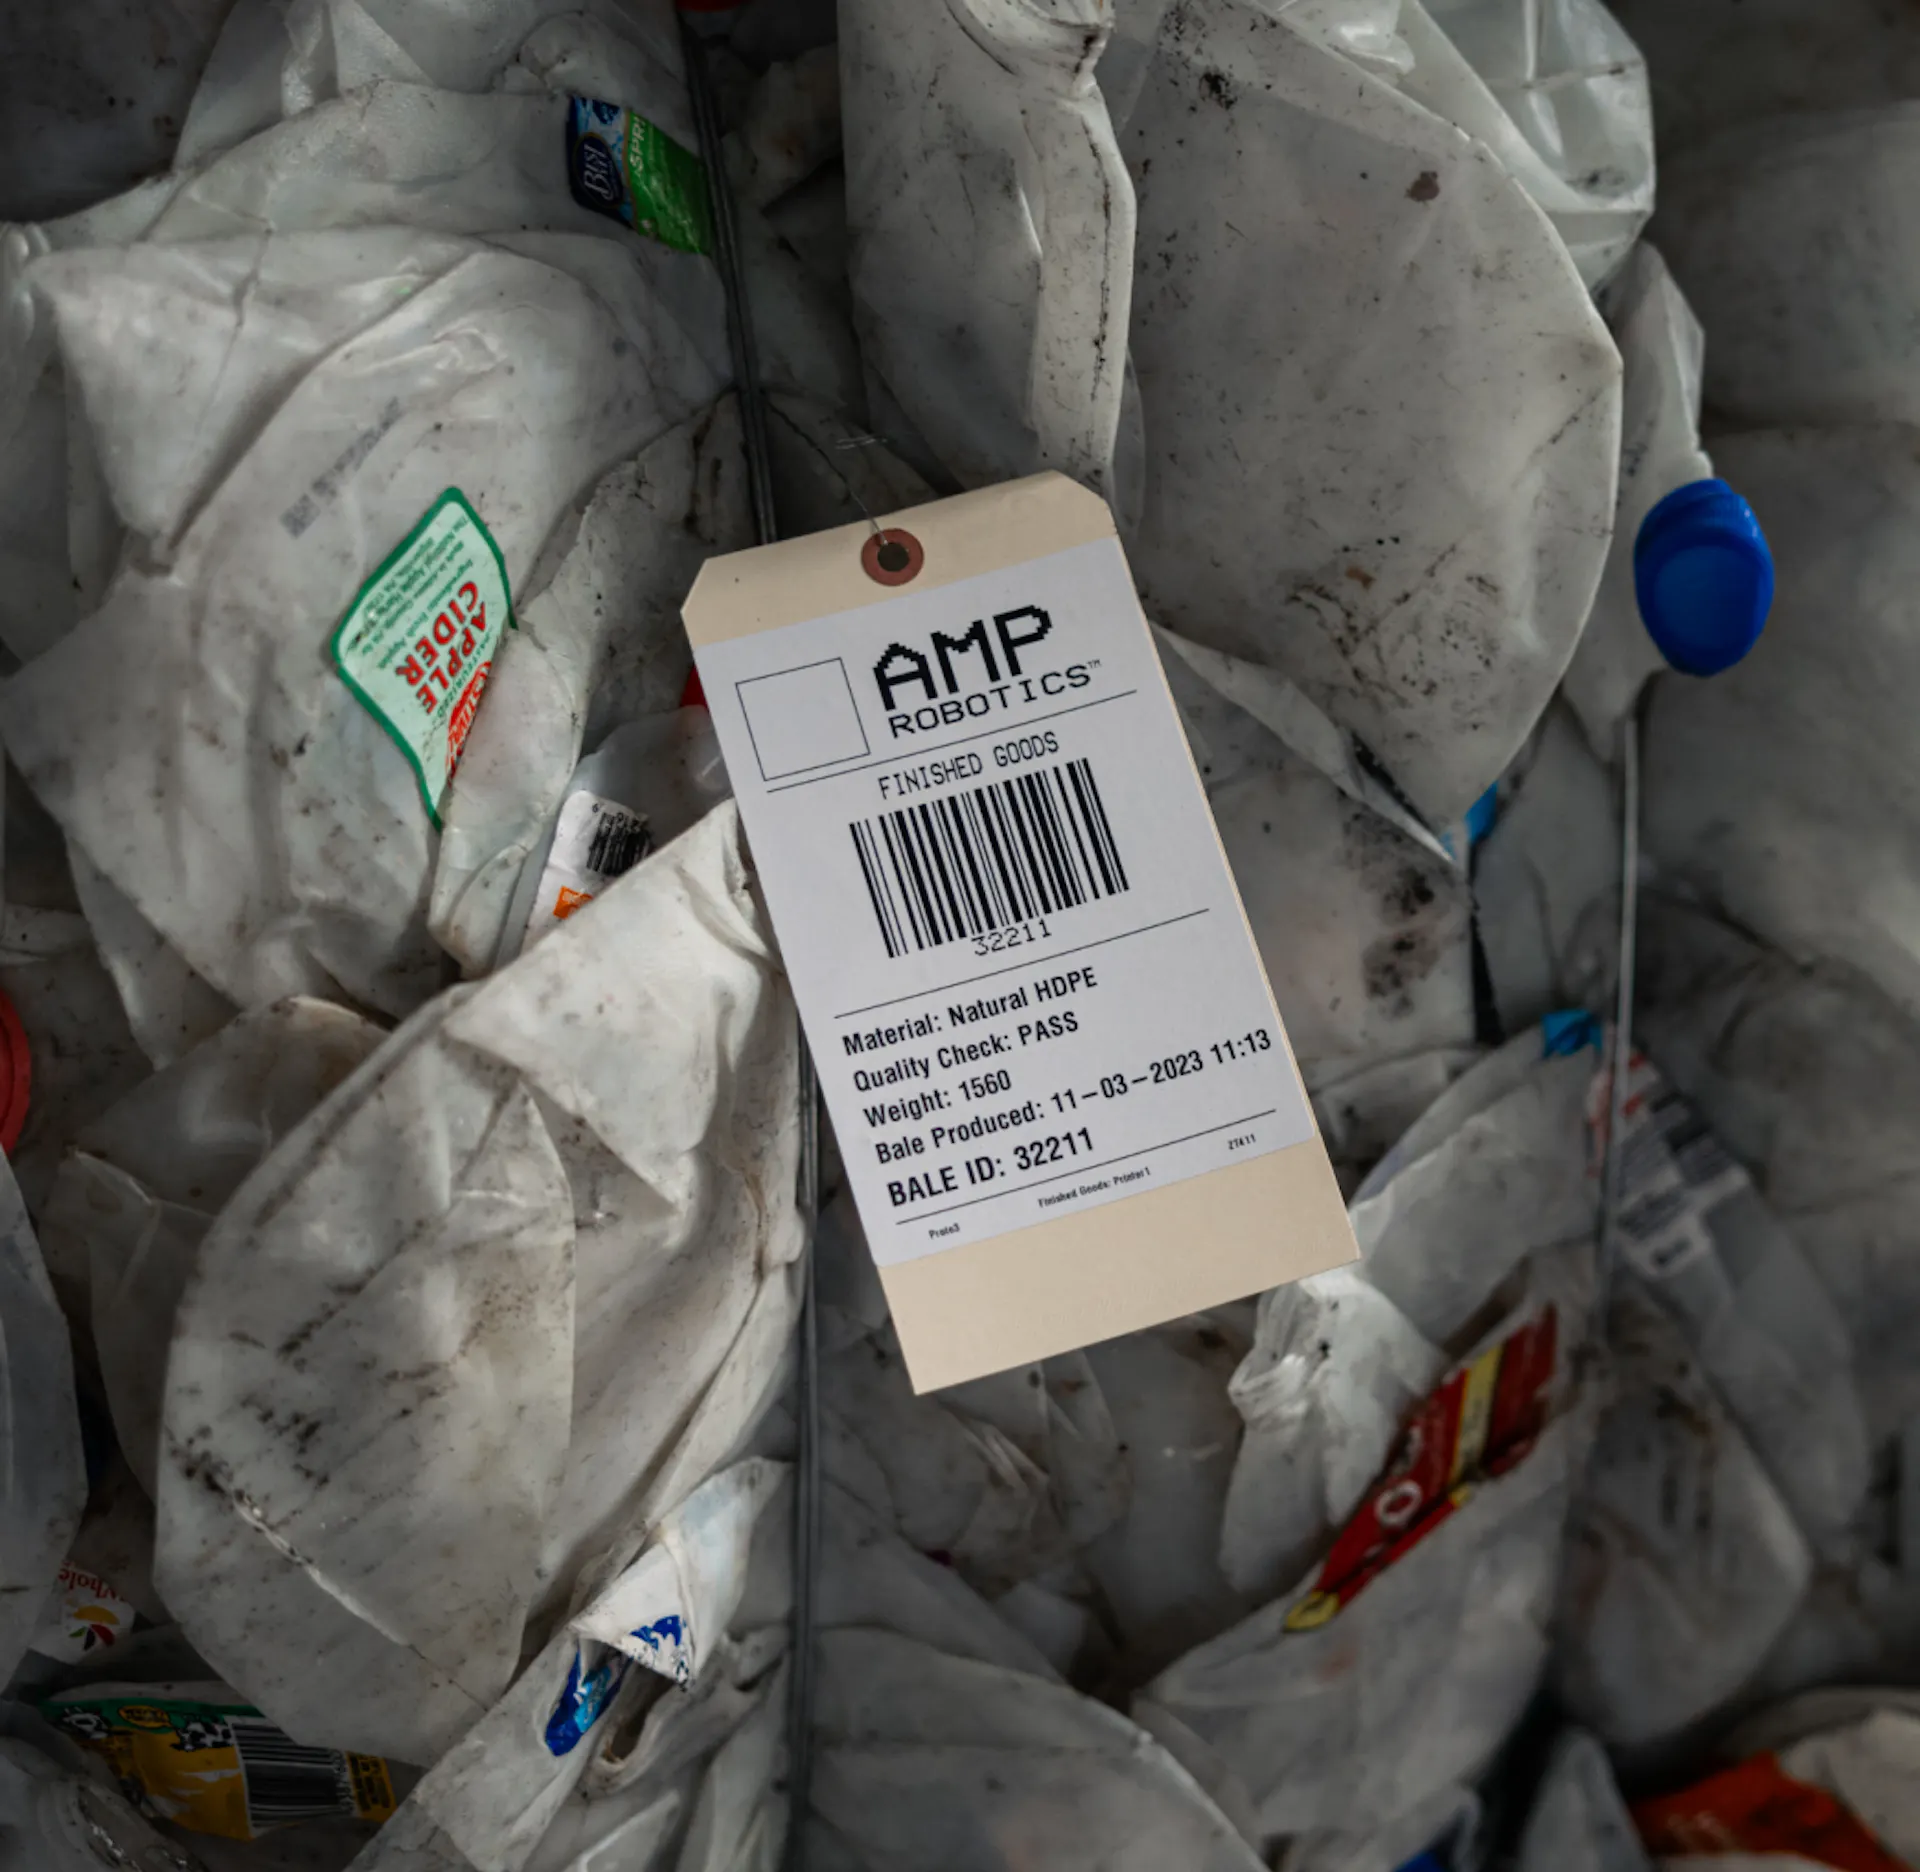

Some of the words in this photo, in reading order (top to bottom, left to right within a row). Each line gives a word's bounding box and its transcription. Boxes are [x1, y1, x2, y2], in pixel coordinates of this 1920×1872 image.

[397, 582, 478, 685] CIDER
[416, 602, 486, 713] APPLE
[872, 605, 1052, 711] AMP
[878, 752, 983, 800] FINISHED
[993, 731, 1059, 767] GOODS
[971, 919, 1051, 956] 32211
[842, 1013, 942, 1056] Material:
[948, 987, 1029, 1027] Natural
[1034, 966, 1098, 1002] HDPE
[853, 1057, 929, 1092] Quality
[937, 1034, 1012, 1069] Check:
[1017, 1011, 1078, 1046] PASS
[863, 1089, 951, 1127] Weight:
[958, 1069, 1012, 1101] 1560
[875, 1136, 925, 1164] Bale
[931, 1101, 1044, 1148] Produced:
[1210, 1029, 1271, 1064] 11:13
[887, 1166, 958, 1207] BALE
[965, 1156, 1005, 1185] ID:
[1013, 1127, 1093, 1170] 32211
[1038, 1187, 1079, 1207] Finished
